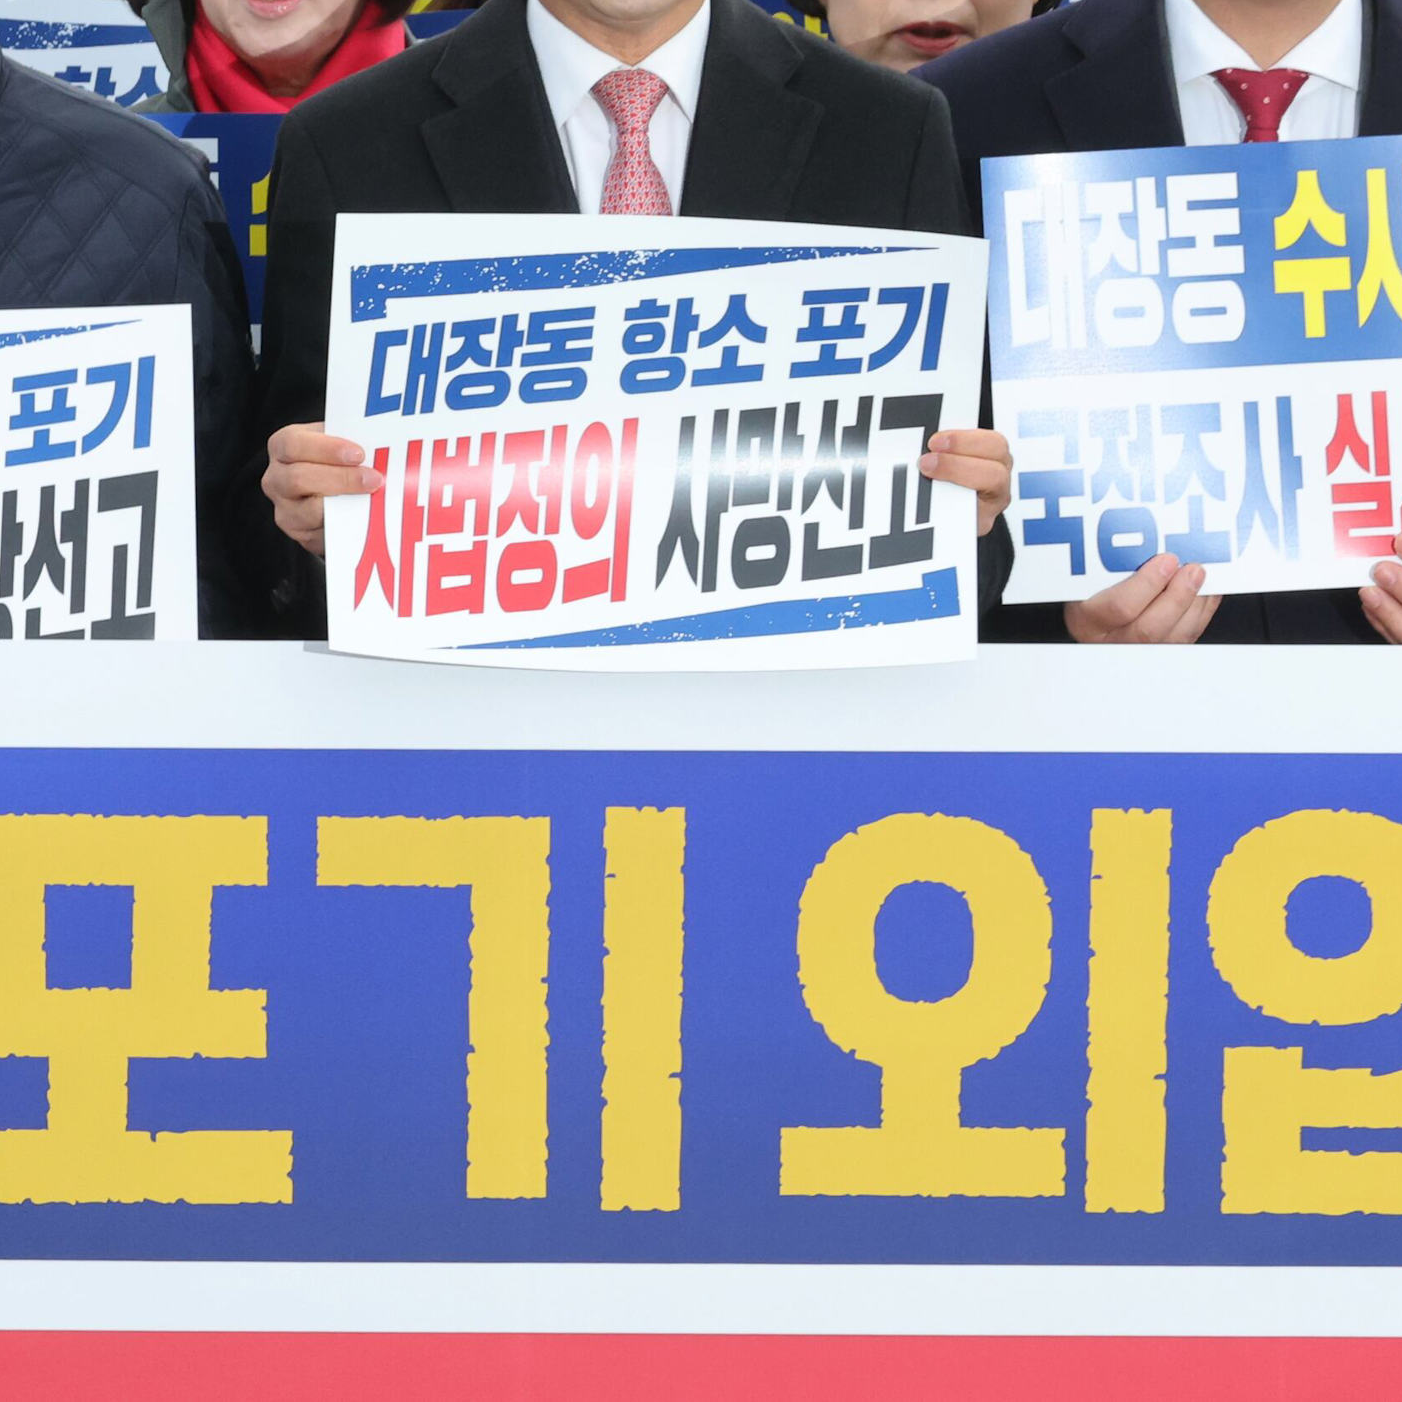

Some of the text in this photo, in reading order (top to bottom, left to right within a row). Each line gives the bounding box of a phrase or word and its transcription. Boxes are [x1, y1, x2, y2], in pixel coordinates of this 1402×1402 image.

[364, 283, 950, 418] 대장동 항소 포기
[1003, 172, 1246, 352] 대장동
[4, 355, 156, 468] 포기
[1016, 396, 1304, 578] 국정조사
[353, 393, 944, 619] 사법정의 사망선고
